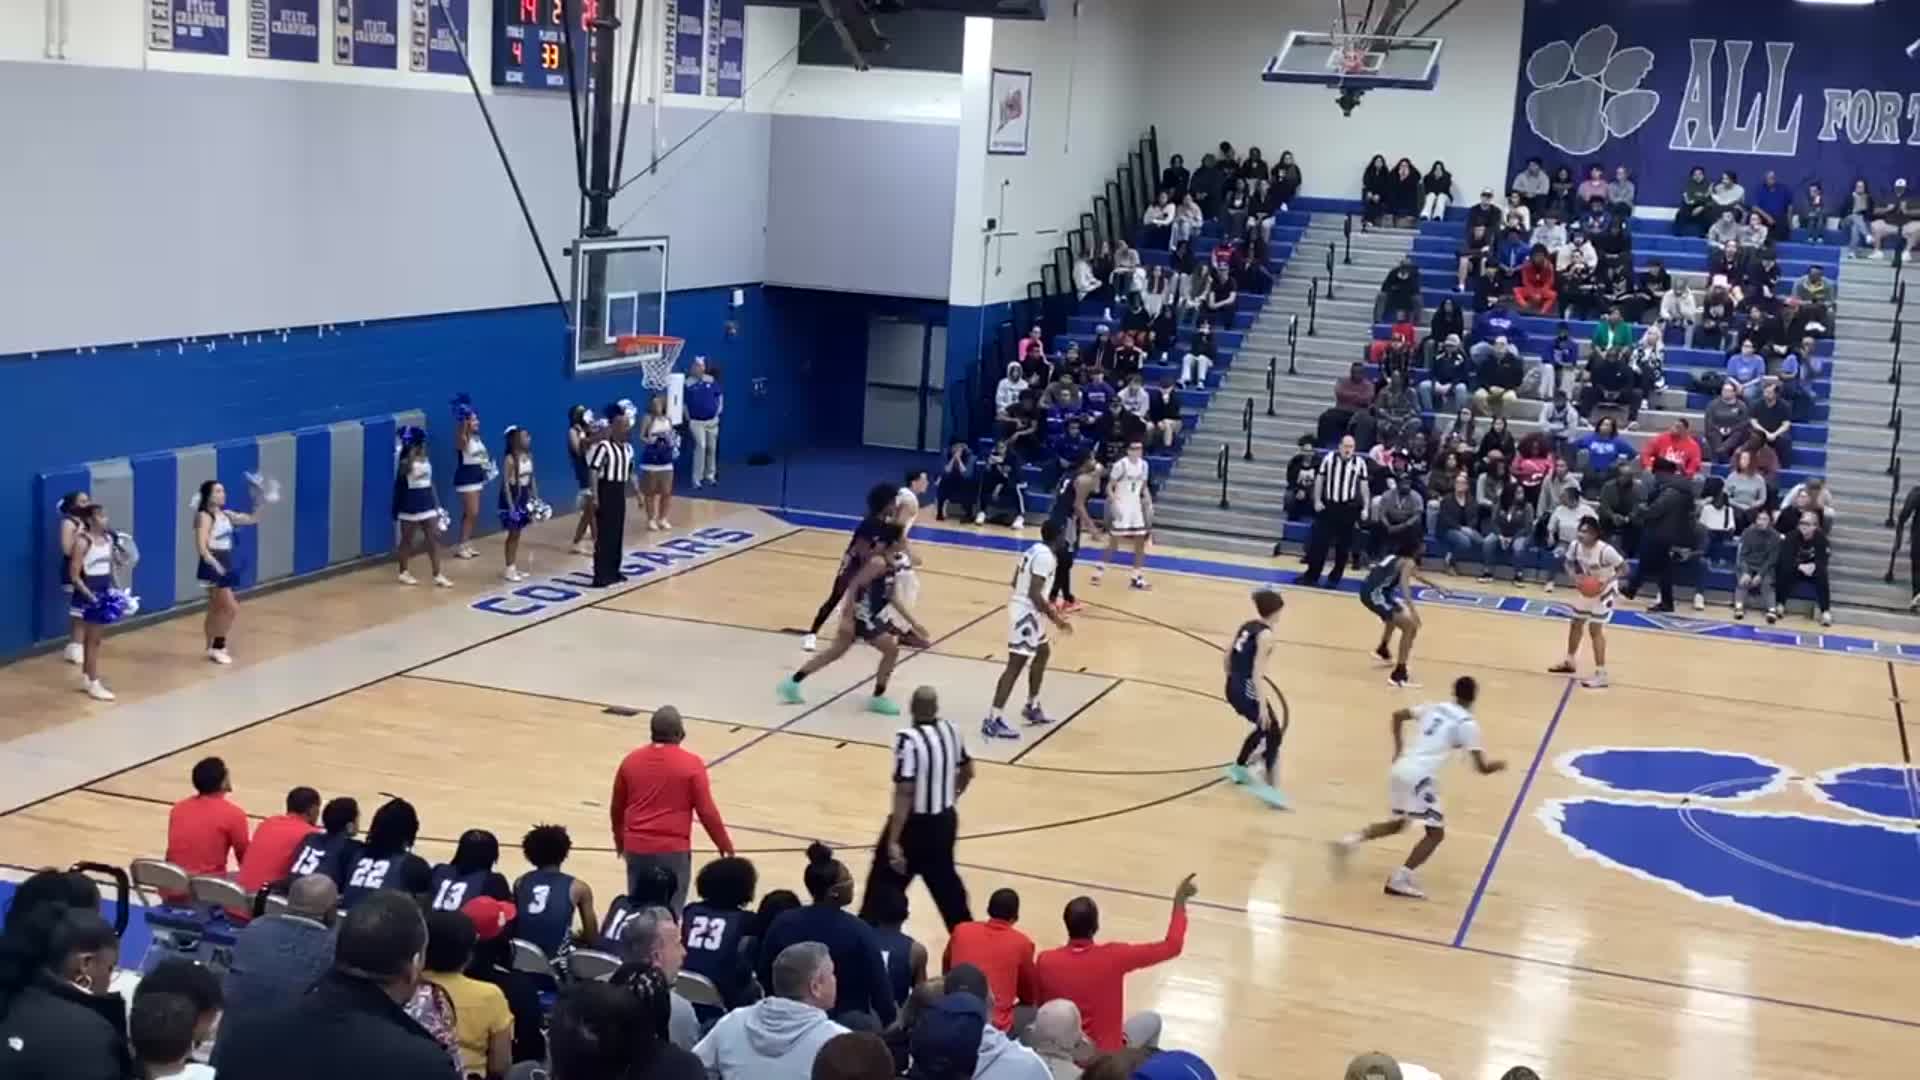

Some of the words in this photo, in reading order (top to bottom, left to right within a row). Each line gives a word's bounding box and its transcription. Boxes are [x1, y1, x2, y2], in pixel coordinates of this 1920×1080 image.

[1668, 38, 1803, 157] ALL
[1817, 88, 1904, 145] FOR
[291, 846, 326, 875] 15
[350, 858, 390, 889] 22
[432, 879, 468, 911] 13
[528, 885, 551, 914] 3
[687, 916, 727, 951] 23
